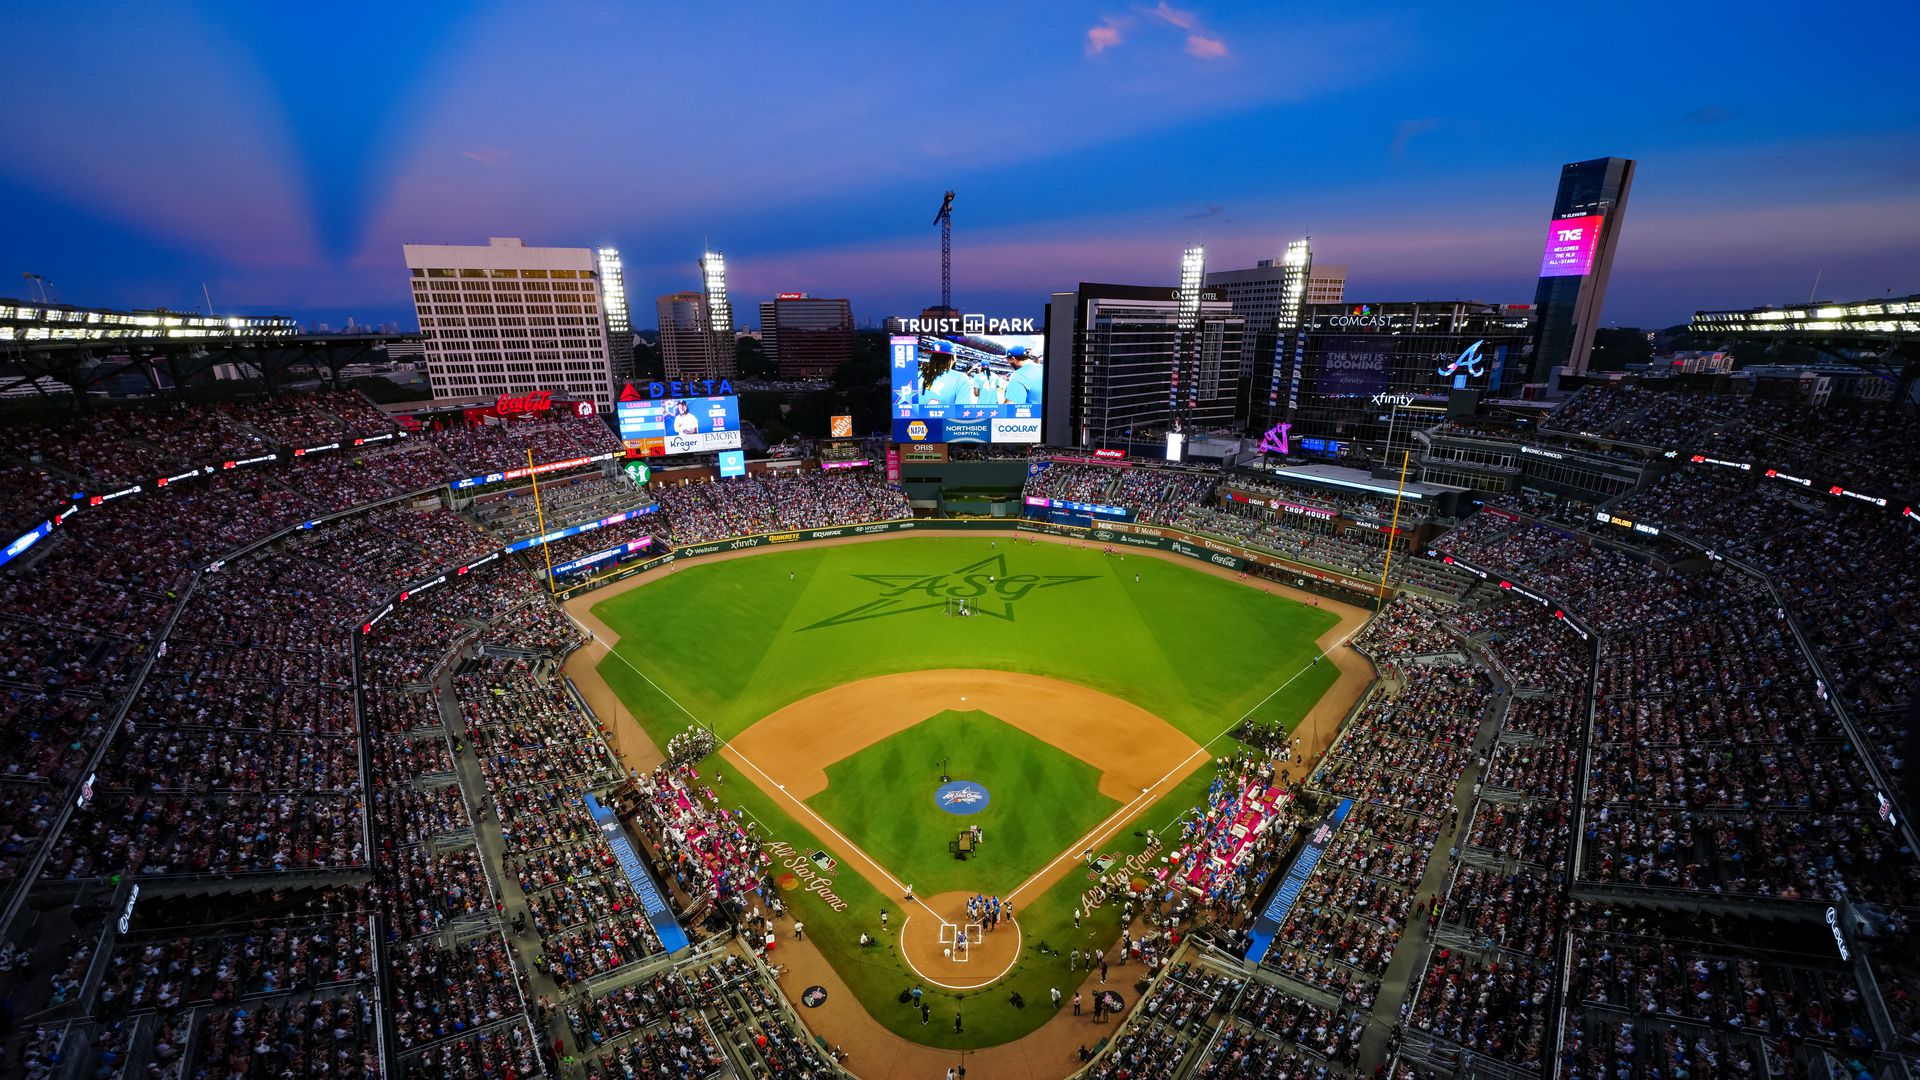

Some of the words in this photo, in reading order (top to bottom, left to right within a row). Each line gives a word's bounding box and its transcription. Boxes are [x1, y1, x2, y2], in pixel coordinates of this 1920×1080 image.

[1558, 228, 1583, 242] TKE
[898, 318, 960, 332] TRUIST
[989, 318, 1034, 332] PARK
[1330, 316, 1393, 326] COMCAST
[1328, 352, 1348, 361] THE
[1350, 353, 1371, 362] WIFI
[1372, 354, 1384, 362] IS
[1326, 360, 1382, 370] BOOMING
[650, 379, 733, 398] DELTA
[496, 391, 552, 415] Coca-Cola
[1372, 392, 1414, 406] xfinity
[713, 417, 724, 426] 18
[704, 431, 738, 442] EMORY
[910, 426, 925, 435] NAPA
[670, 436, 698, 452] Kroger
[1248, 498, 1265, 506] LIGHT
[1284, 506, 1304, 514] CHOP
[1306, 510, 1330, 520] HOUSE
[768, 534, 800, 542] QUIKRETE
[812, 530, 842, 538] EQUIFAX
[1142, 528, 1162, 536] Mobile
[730, 538, 758, 550] xfinity
[1128, 537, 1144, 545] Georgia
[694, 546, 720, 554] Wellstar
[1211, 554, 1236, 568] Coca-Cola
[609, 836, 646, 882] AMERICAN
[632, 876, 666, 916] LEAGUE
[762, 842, 796, 858] All
[784, 856, 816, 882] Star
[804, 877, 848, 912] Game
[1264, 876, 1306, 924] NATIONAL
[1293, 844, 1323, 880] LEAGUE
[1830, 921, 1849, 961] LEXUS
